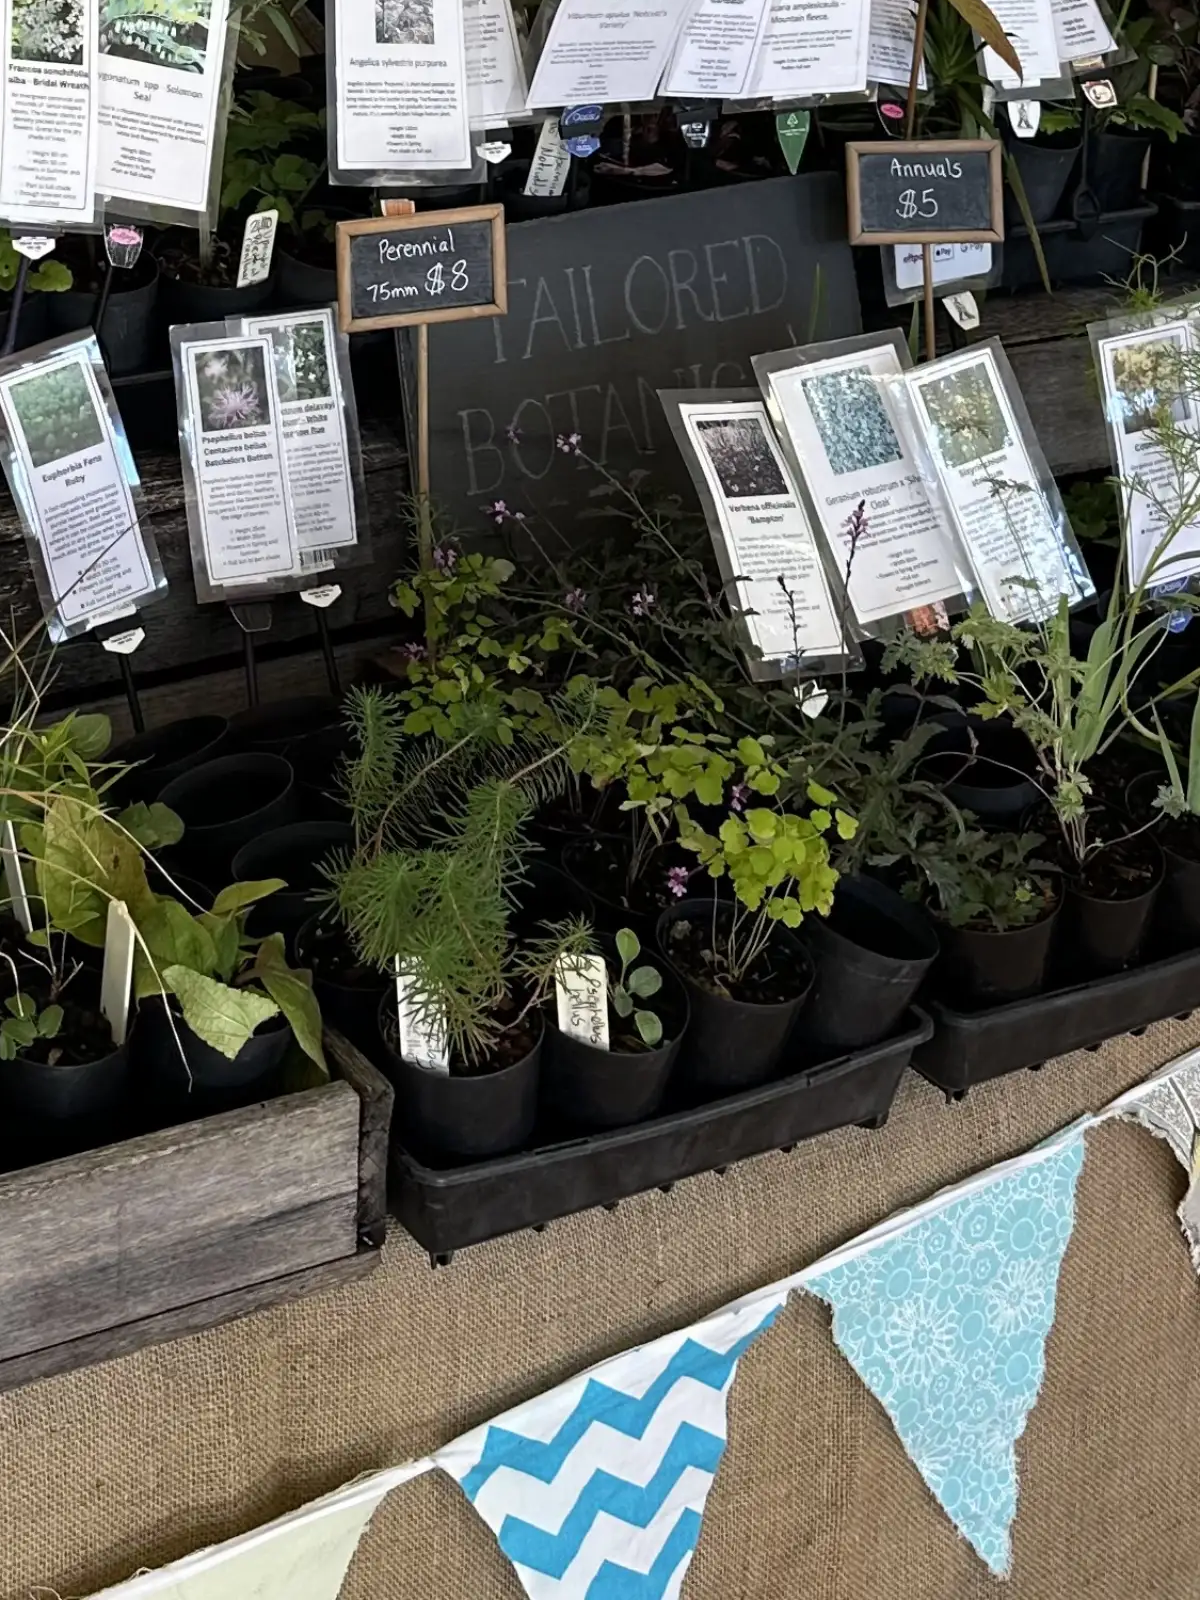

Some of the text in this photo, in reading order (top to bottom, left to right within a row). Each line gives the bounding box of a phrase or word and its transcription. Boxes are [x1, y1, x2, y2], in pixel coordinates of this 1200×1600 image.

[890, 158, 963, 179] Annuals
[895, 188, 939, 219] $5
[378, 228, 455, 264] Perennial
[366, 259, 469, 302] 75mm $8
